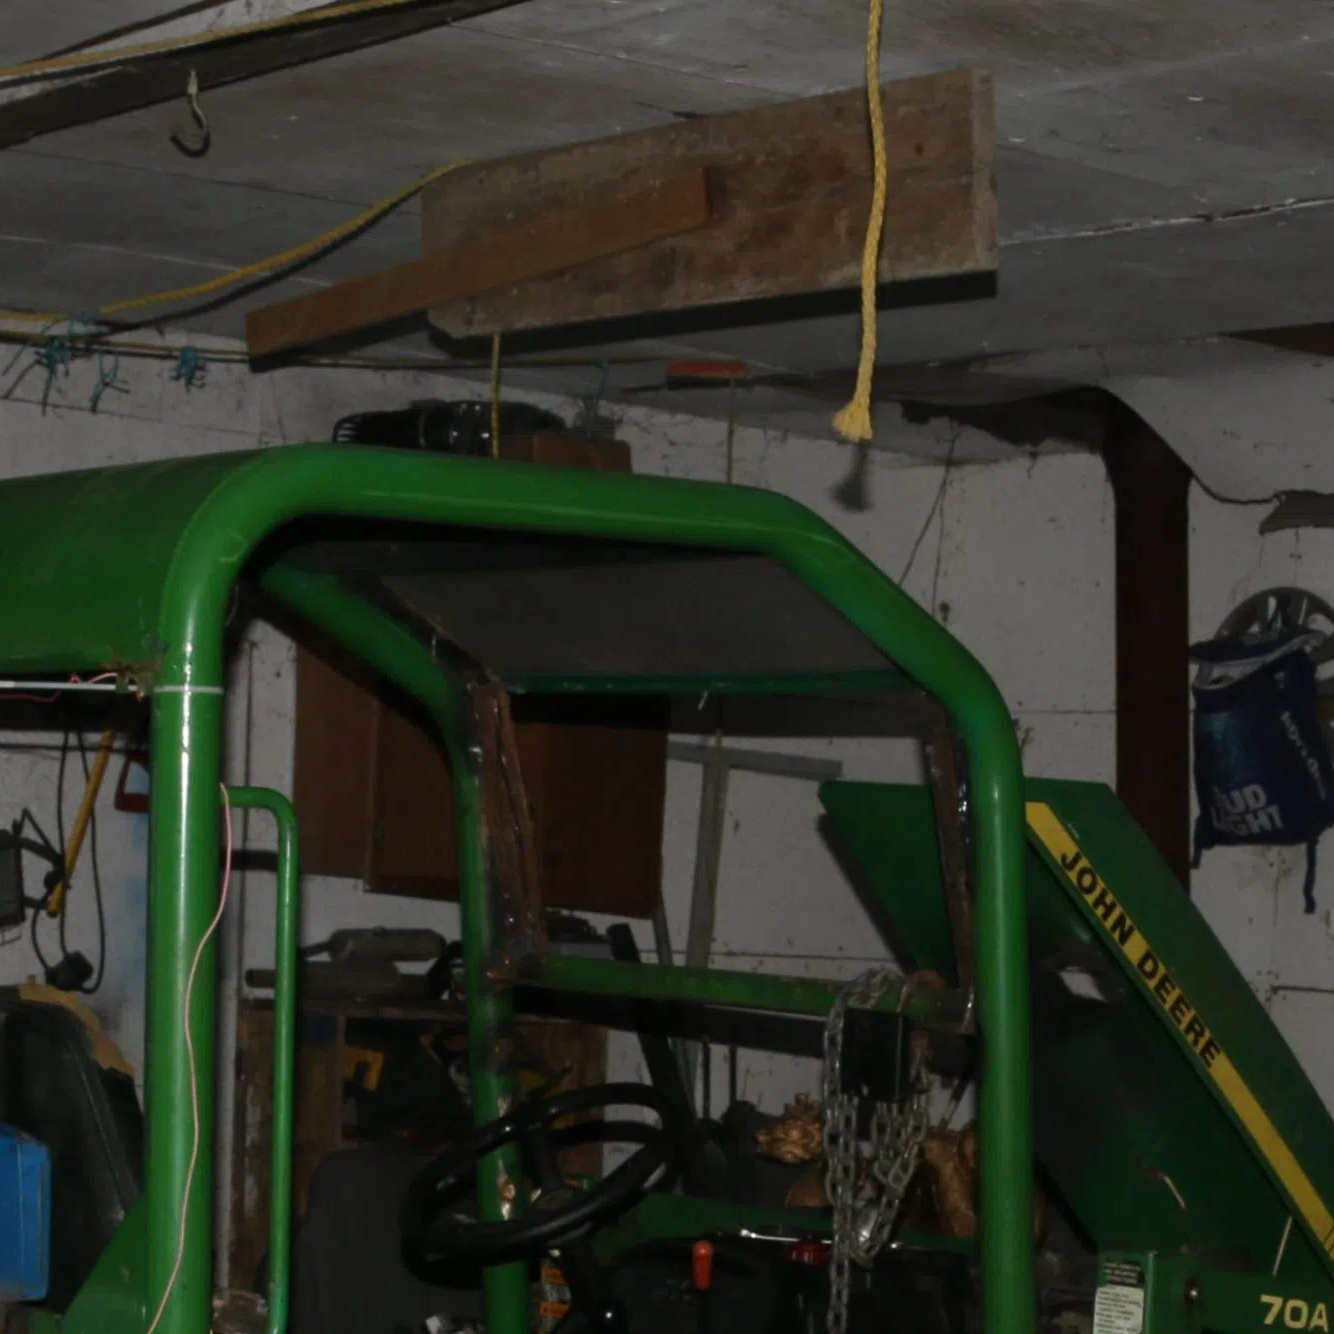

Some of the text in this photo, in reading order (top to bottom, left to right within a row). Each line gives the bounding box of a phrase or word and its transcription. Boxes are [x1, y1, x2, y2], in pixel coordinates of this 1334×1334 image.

[1061, 851, 1221, 1068] JOHN DEERE
[1259, 1293, 1330, 1333] 70A
